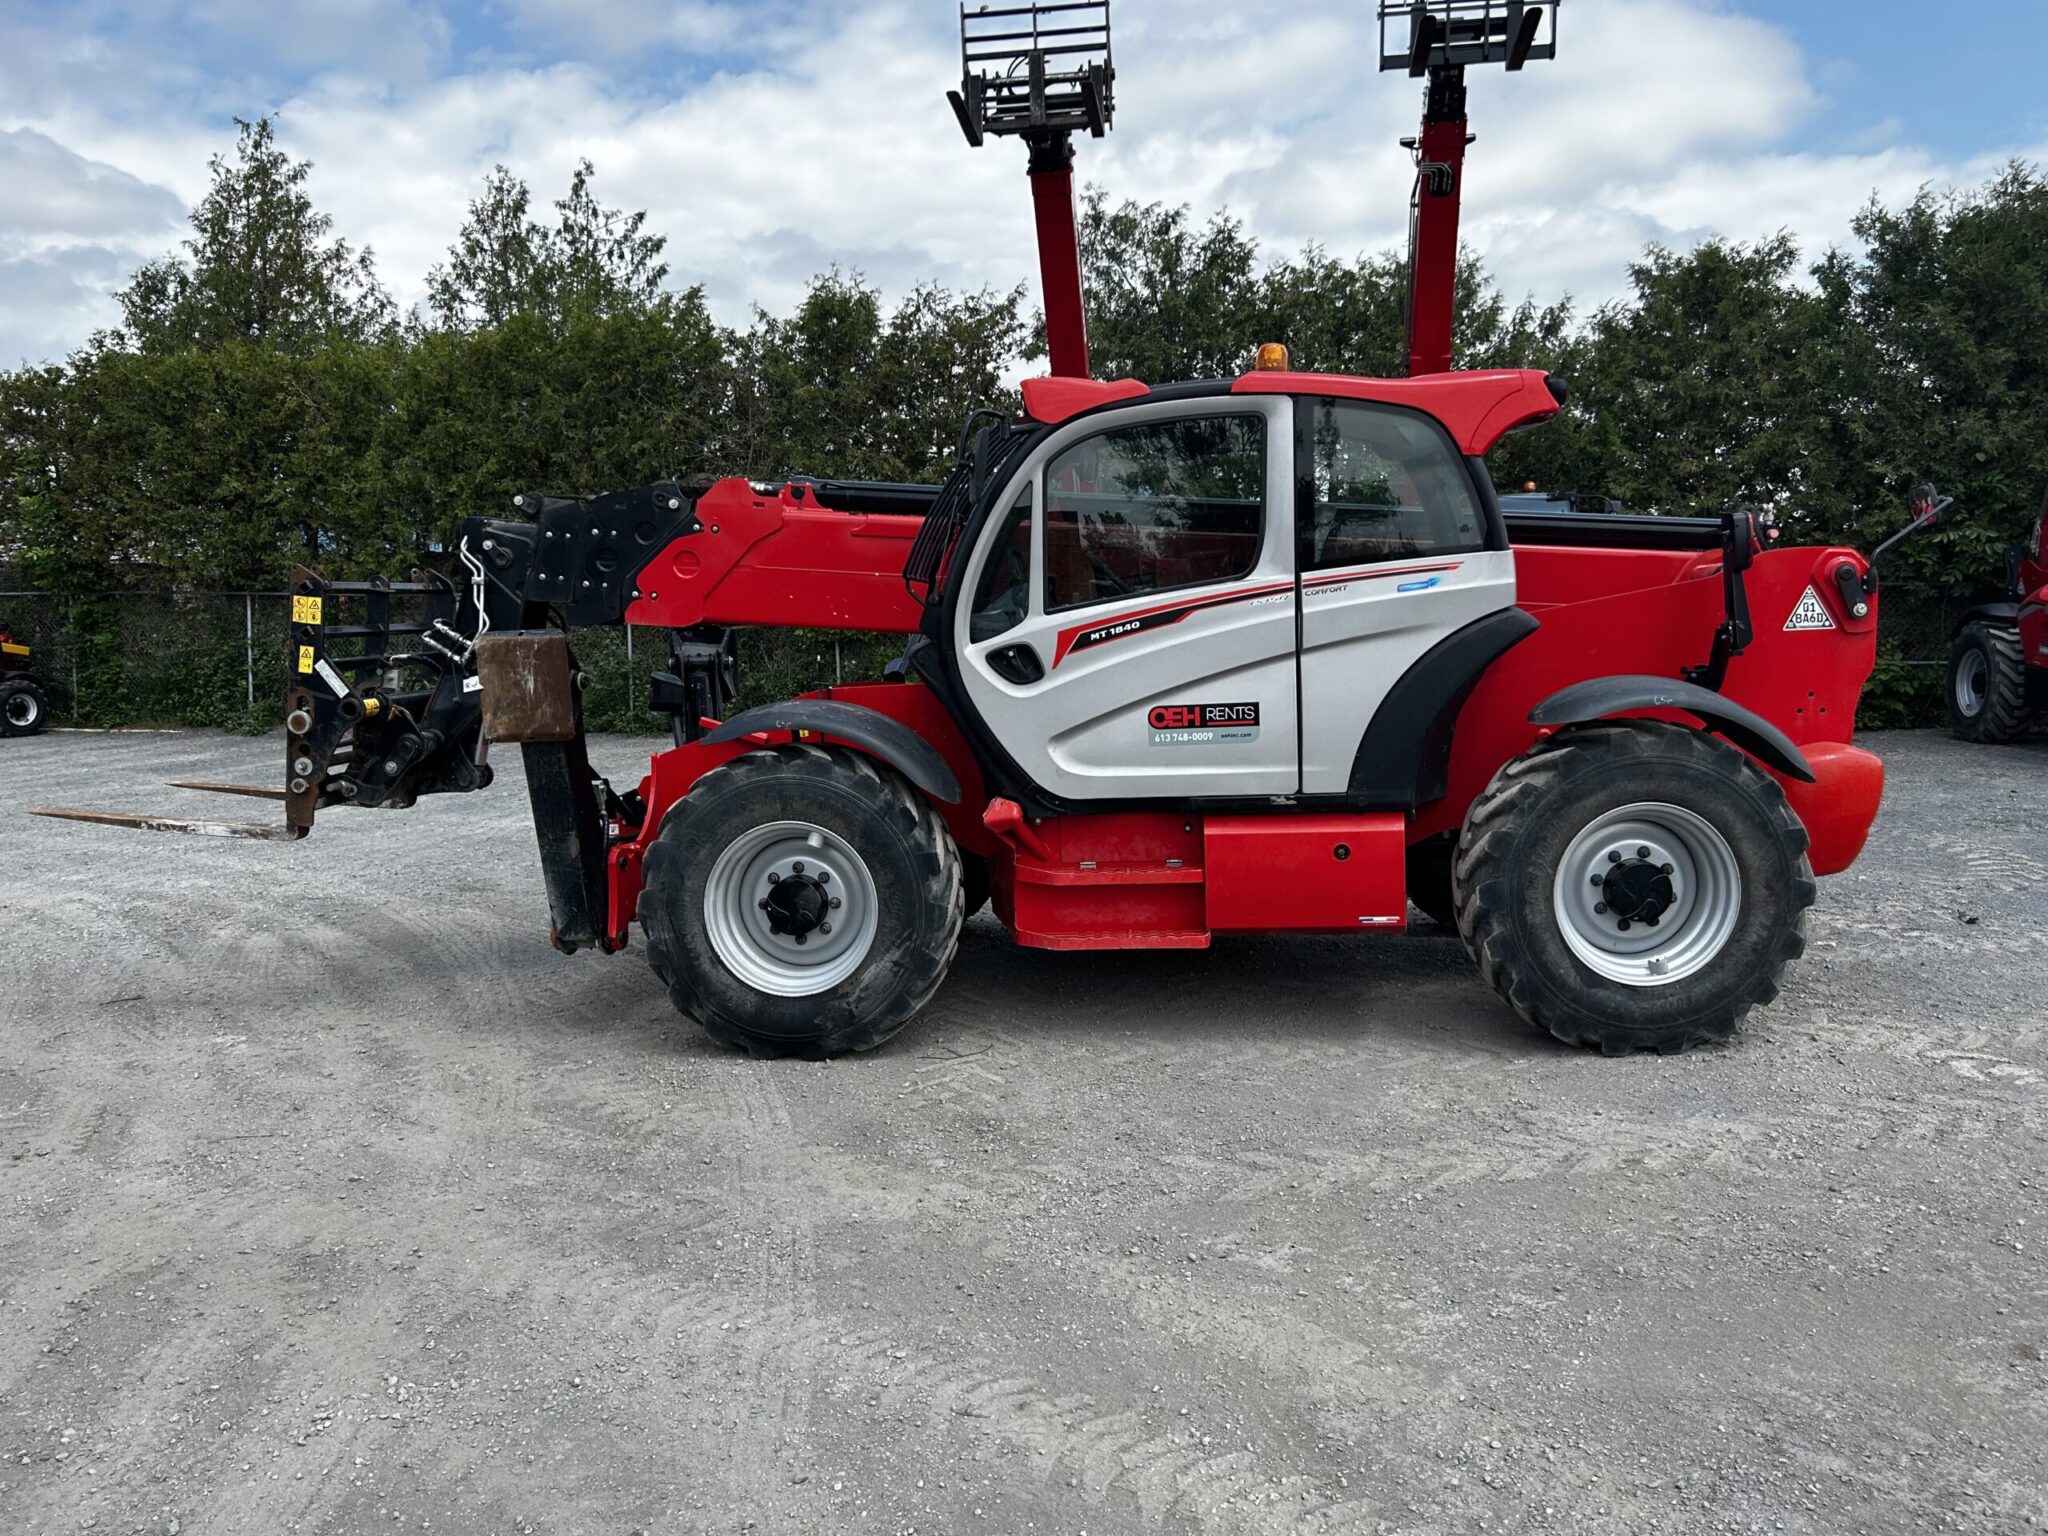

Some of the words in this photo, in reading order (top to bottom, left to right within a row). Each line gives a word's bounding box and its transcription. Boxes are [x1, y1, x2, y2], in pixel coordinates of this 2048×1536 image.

[1795, 612, 1824, 624] BA6D
[1090, 630, 1107, 641] MT
[1109, 621, 1140, 635] 1840
[1149, 706, 1200, 729] OEH
[1206, 706, 1255, 720] RENTS
[1154, 733, 1171, 743] 613
[1173, 732, 1214, 742] 748-0009
